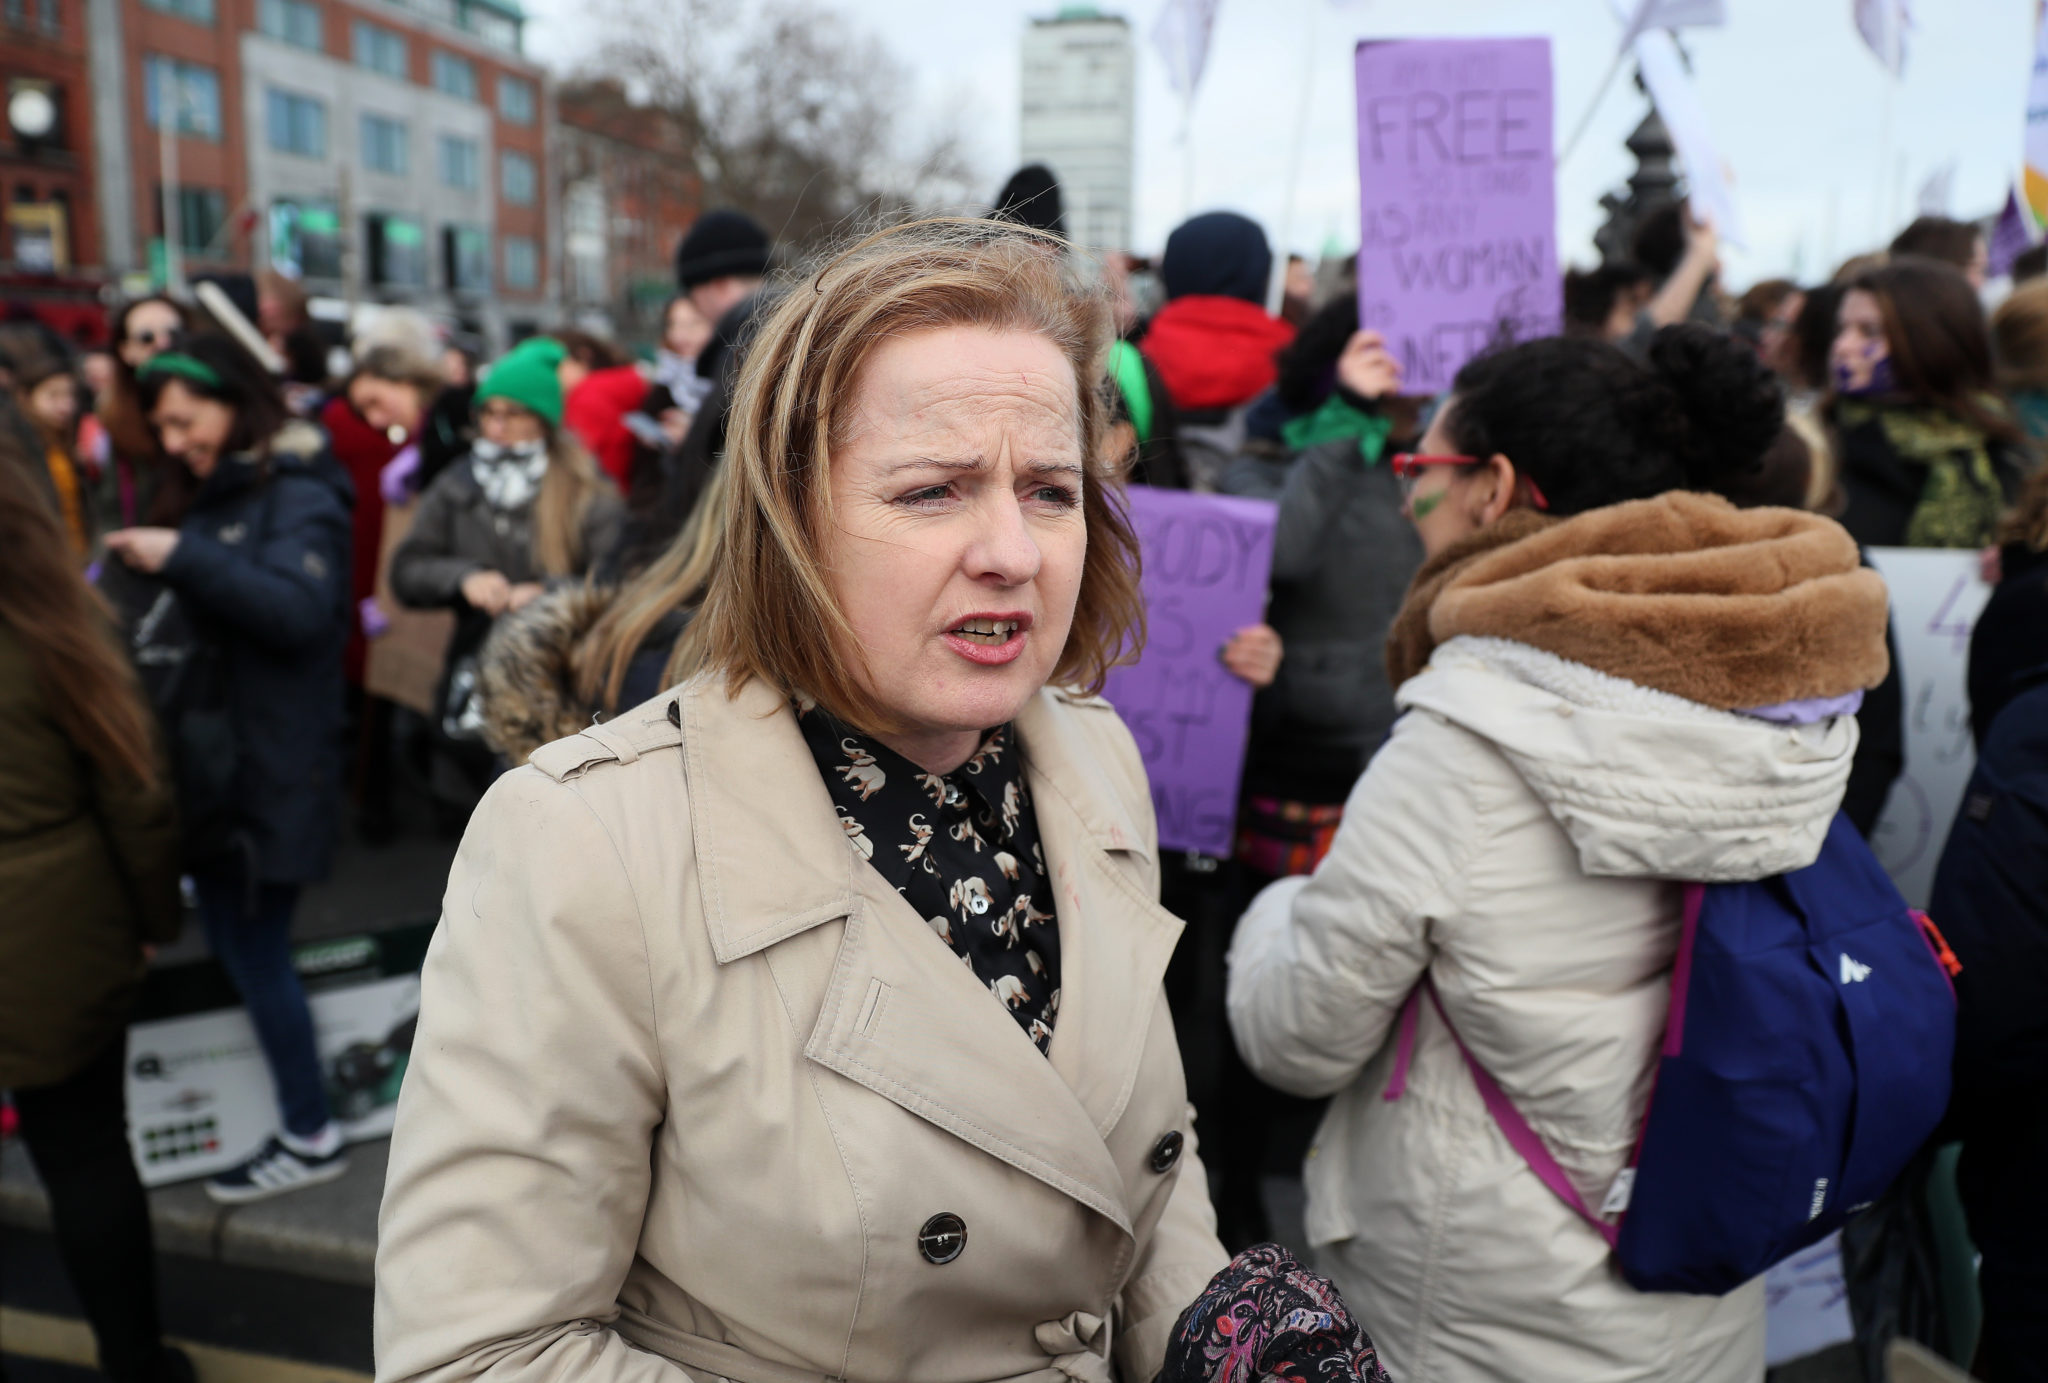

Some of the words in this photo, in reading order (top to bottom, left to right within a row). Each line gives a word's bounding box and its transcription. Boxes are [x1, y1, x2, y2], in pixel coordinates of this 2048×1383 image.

[1367, 87, 1544, 165] FREE
[1390, 233, 1545, 294] WOMAN
[1126, 708, 1212, 767] ST
